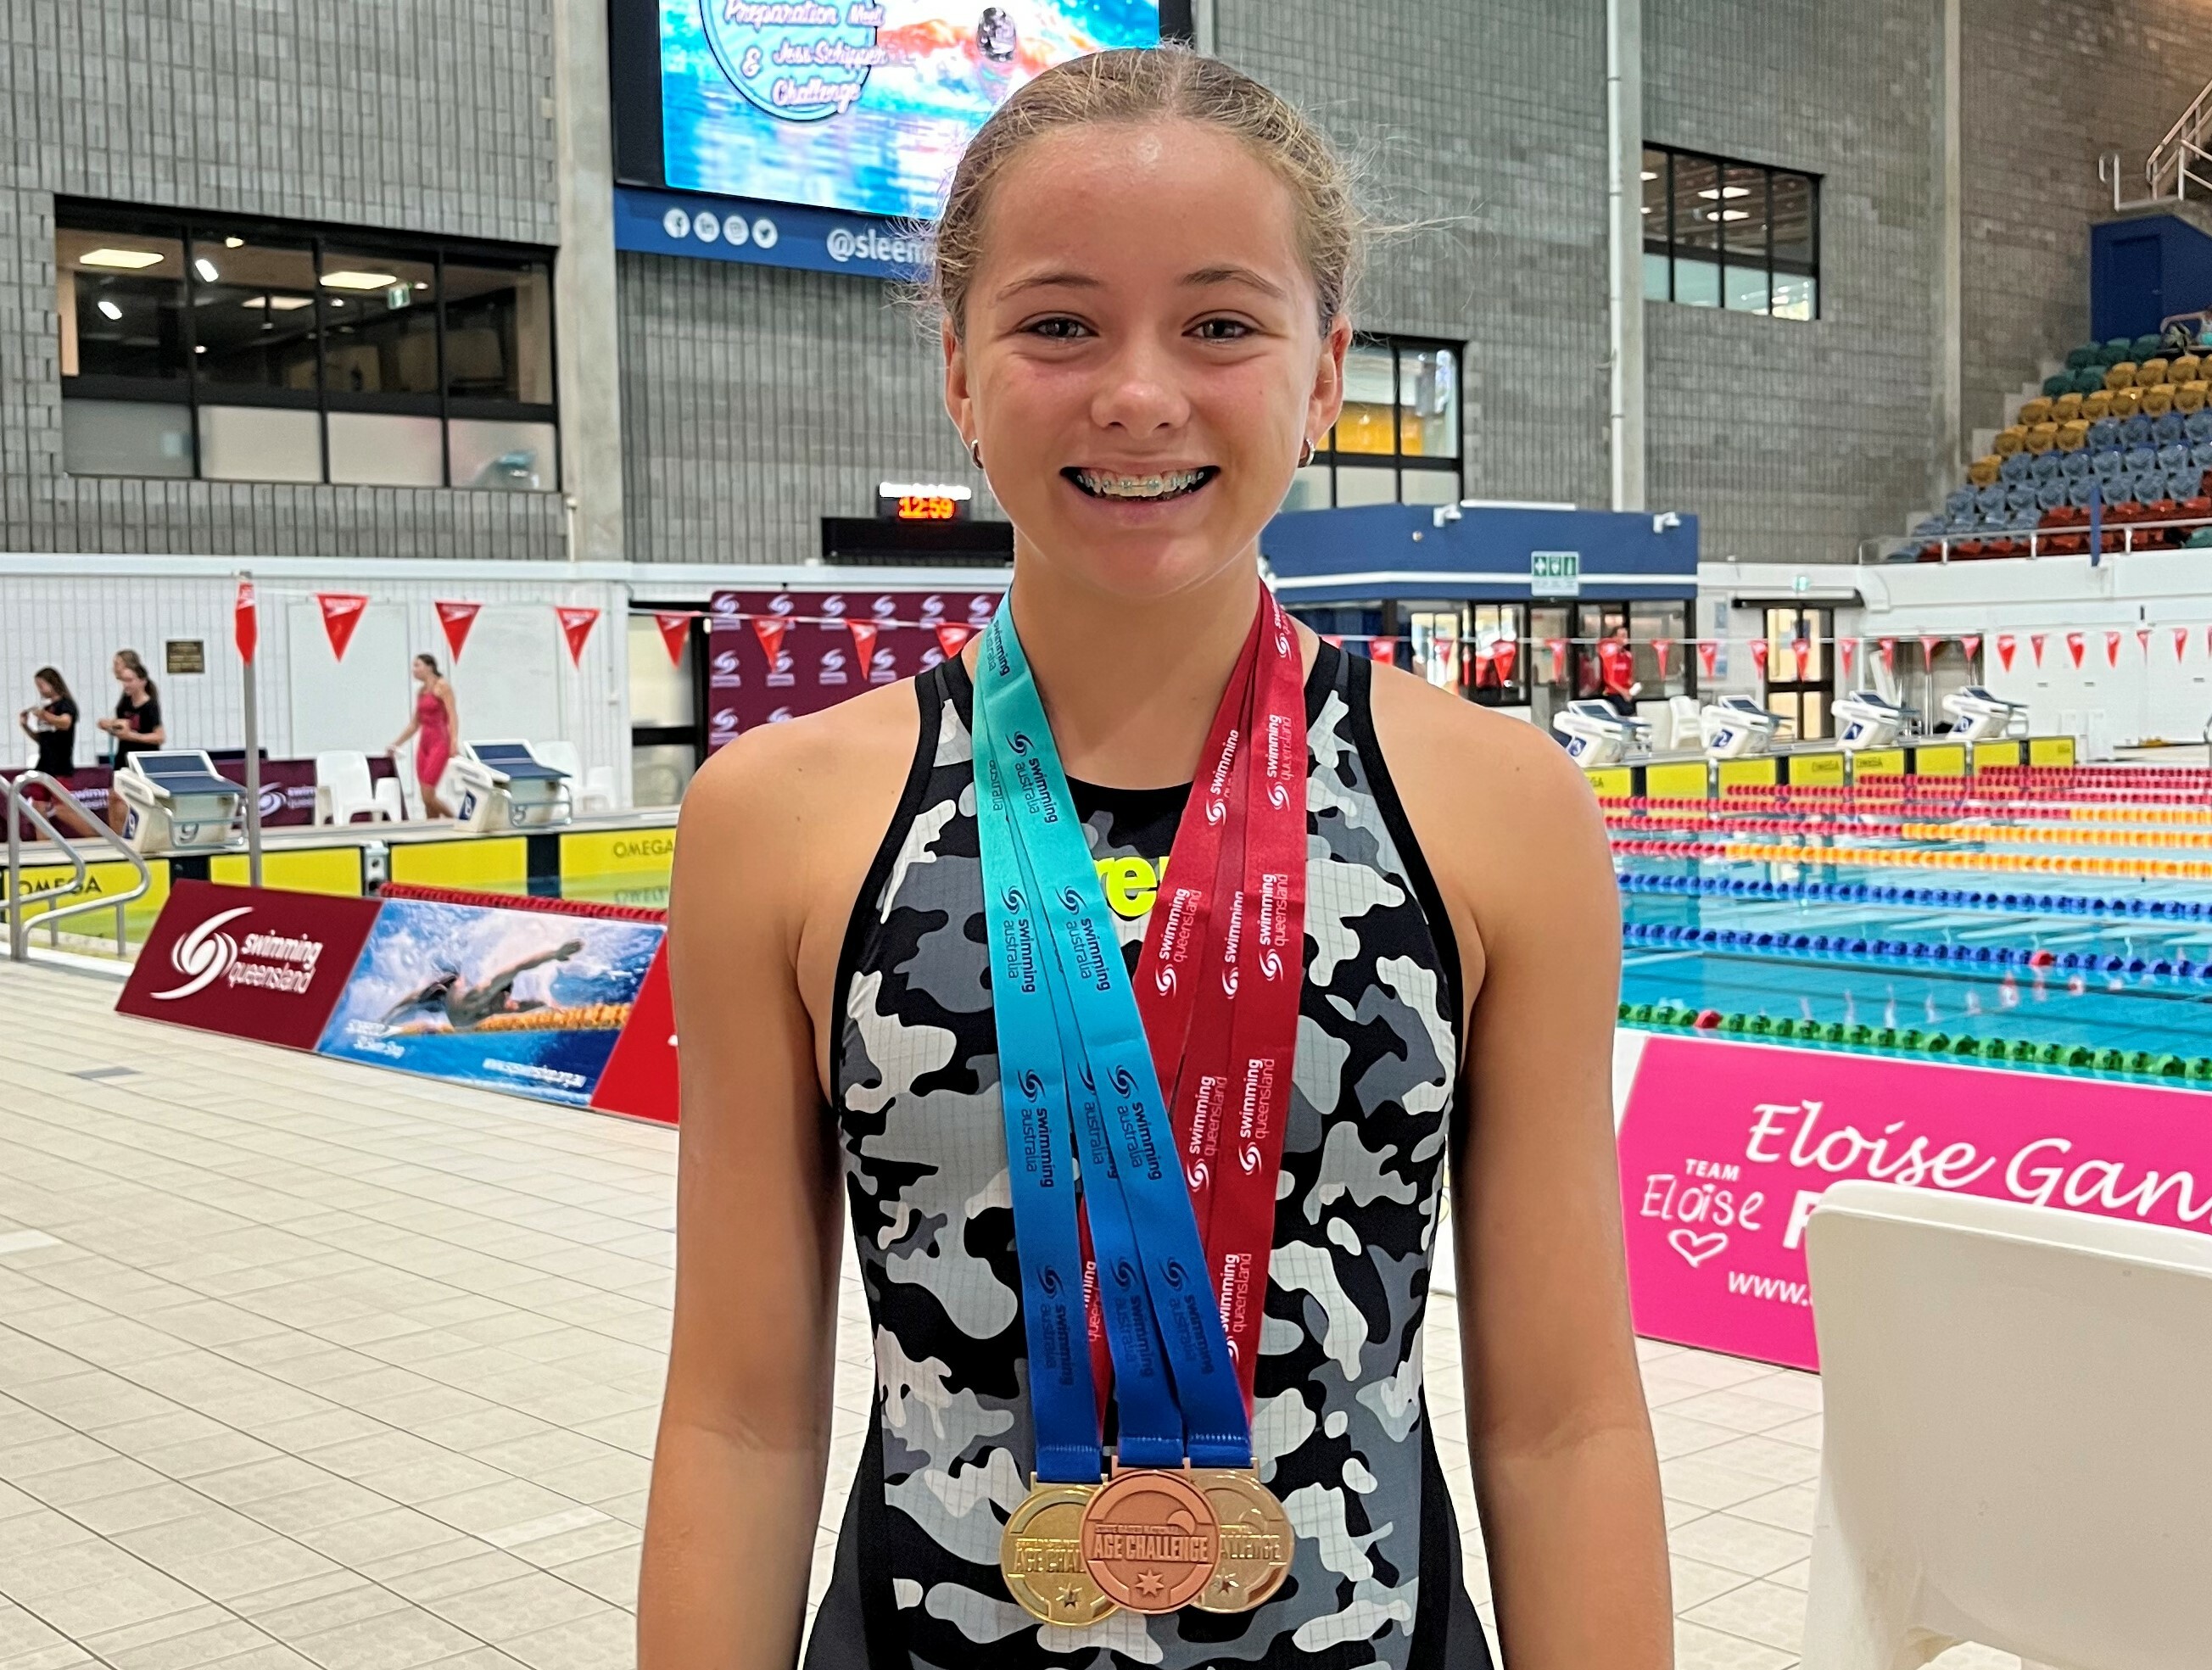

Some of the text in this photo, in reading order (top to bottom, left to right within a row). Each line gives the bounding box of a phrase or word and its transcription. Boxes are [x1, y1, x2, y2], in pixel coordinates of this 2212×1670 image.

[724, 0, 841, 31] Preparation
[741, 47, 762, 77] &
[771, 76, 862, 114] Challenge
[898, 495, 954, 519] 12:59
[993, 618, 1011, 677] swimming
[1265, 714, 1283, 779] swimming
[1280, 716, 1292, 782] queensland
[988, 760, 1004, 812] australia
[1014, 760, 1041, 815] australia
[1029, 757, 1059, 824] swimming
[179, 823, 199, 844] 9
[613, 838, 673, 859] OMEGA
[1159, 888, 1191, 961] swimming
[1173, 889, 1203, 963] queensland
[1256, 873, 1278, 947] swimming
[1274, 873, 1289, 947] queensland
[228, 962, 317, 995] queensland
[241, 929, 324, 970] swimming
[1003, 919, 1020, 980] australia
[1018, 918, 1036, 993] swimming
[1065, 920, 1092, 980] australia
[1080, 917, 1111, 991] swimming
[1189, 1075, 1216, 1155] swimming
[1204, 1076, 1228, 1157] queensland
[1239, 1058, 1264, 1139] swimming
[1254, 1058, 1276, 1140] queensland
[1020, 1108, 1038, 1173] australia
[1036, 1107, 1055, 1188] swimming
[1083, 1101, 1106, 1166] australia
[1116, 1105, 1144, 1169] australia
[1131, 1101, 1163, 1181] swimming
[1744, 1099, 2212, 1223] Eloise Gan
[1684, 1159, 1741, 1182] TEAM
[1219, 1253, 1241, 1332] swimming
[1232, 1253, 1253, 1333] queensland
[1728, 1271, 1814, 1308] www.
[1092, 1533, 1123, 1561] AGE
[1125, 1533, 1209, 1562] CHALLENGE
